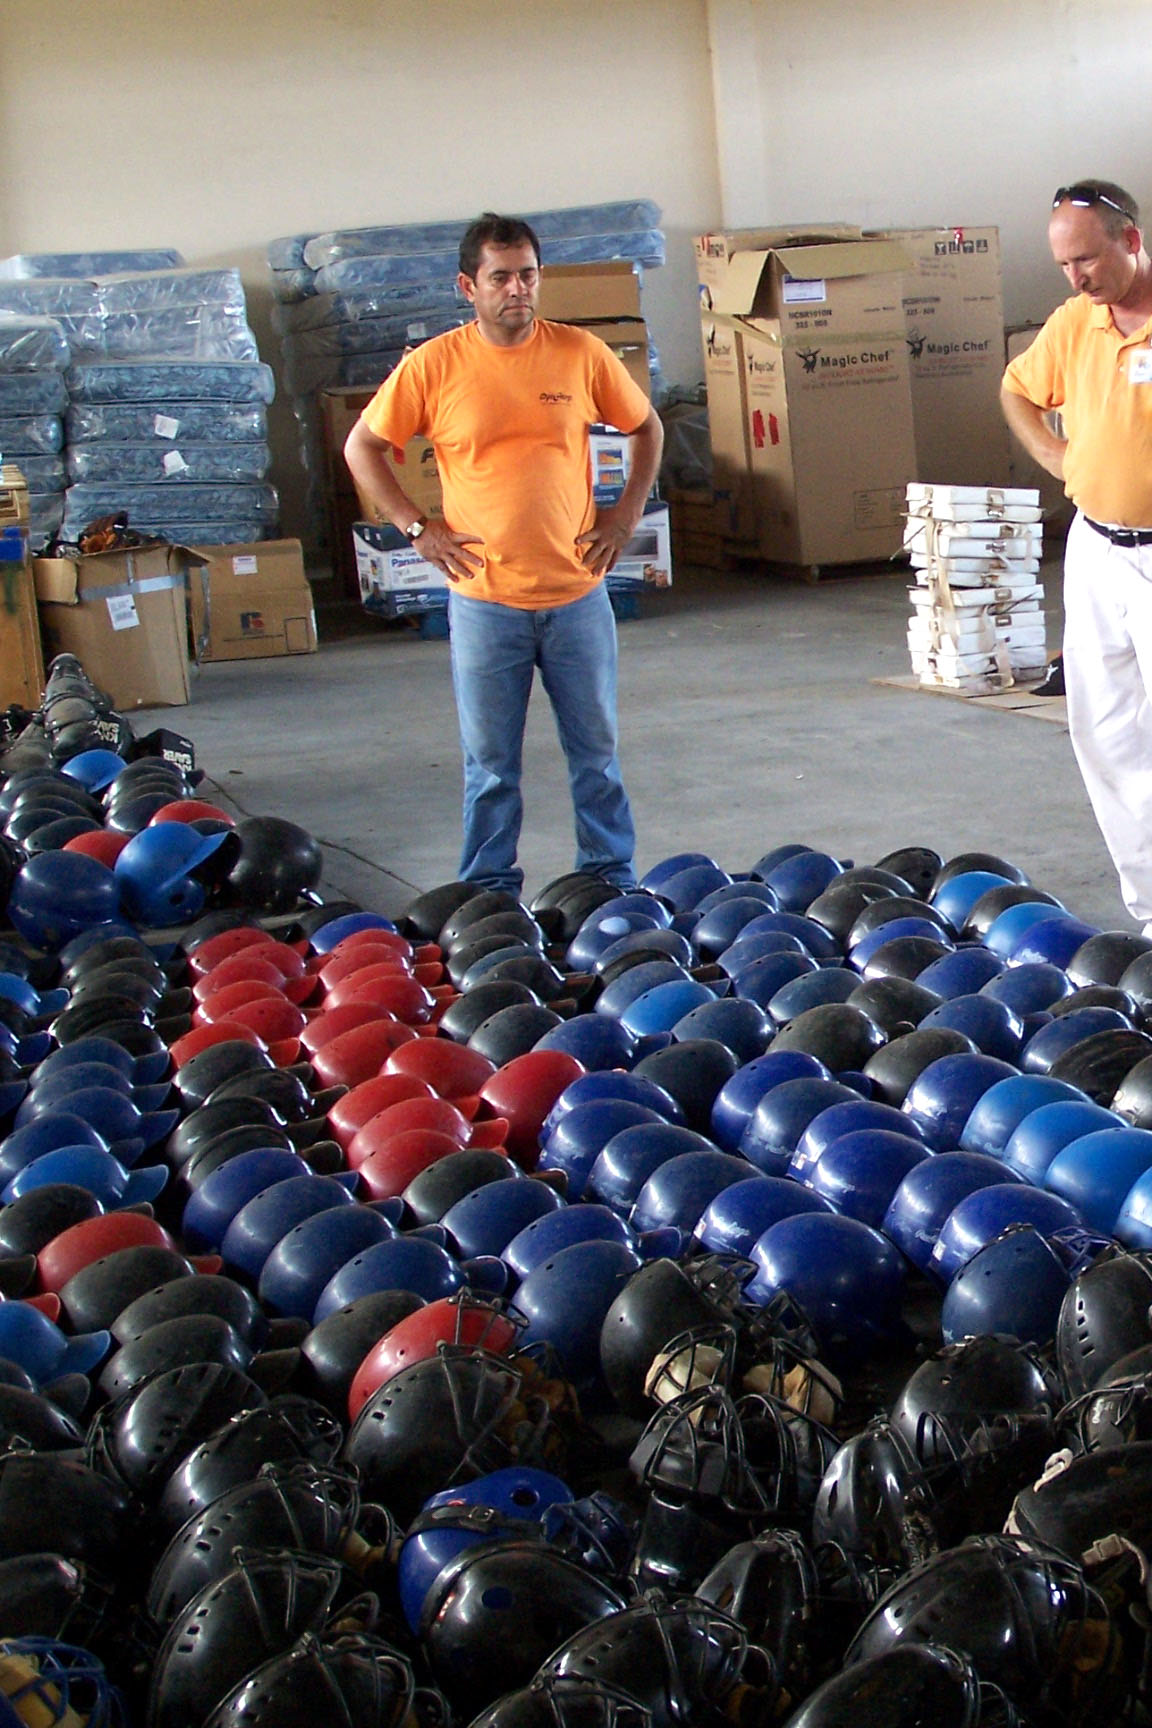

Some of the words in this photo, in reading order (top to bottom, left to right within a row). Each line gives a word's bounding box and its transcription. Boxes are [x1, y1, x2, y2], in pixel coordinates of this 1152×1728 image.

[927, 342, 960, 356] Magic
[963, 339, 989, 353] Chef
[820, 353, 858, 369] Magic
[860, 349, 890, 365] Chef
